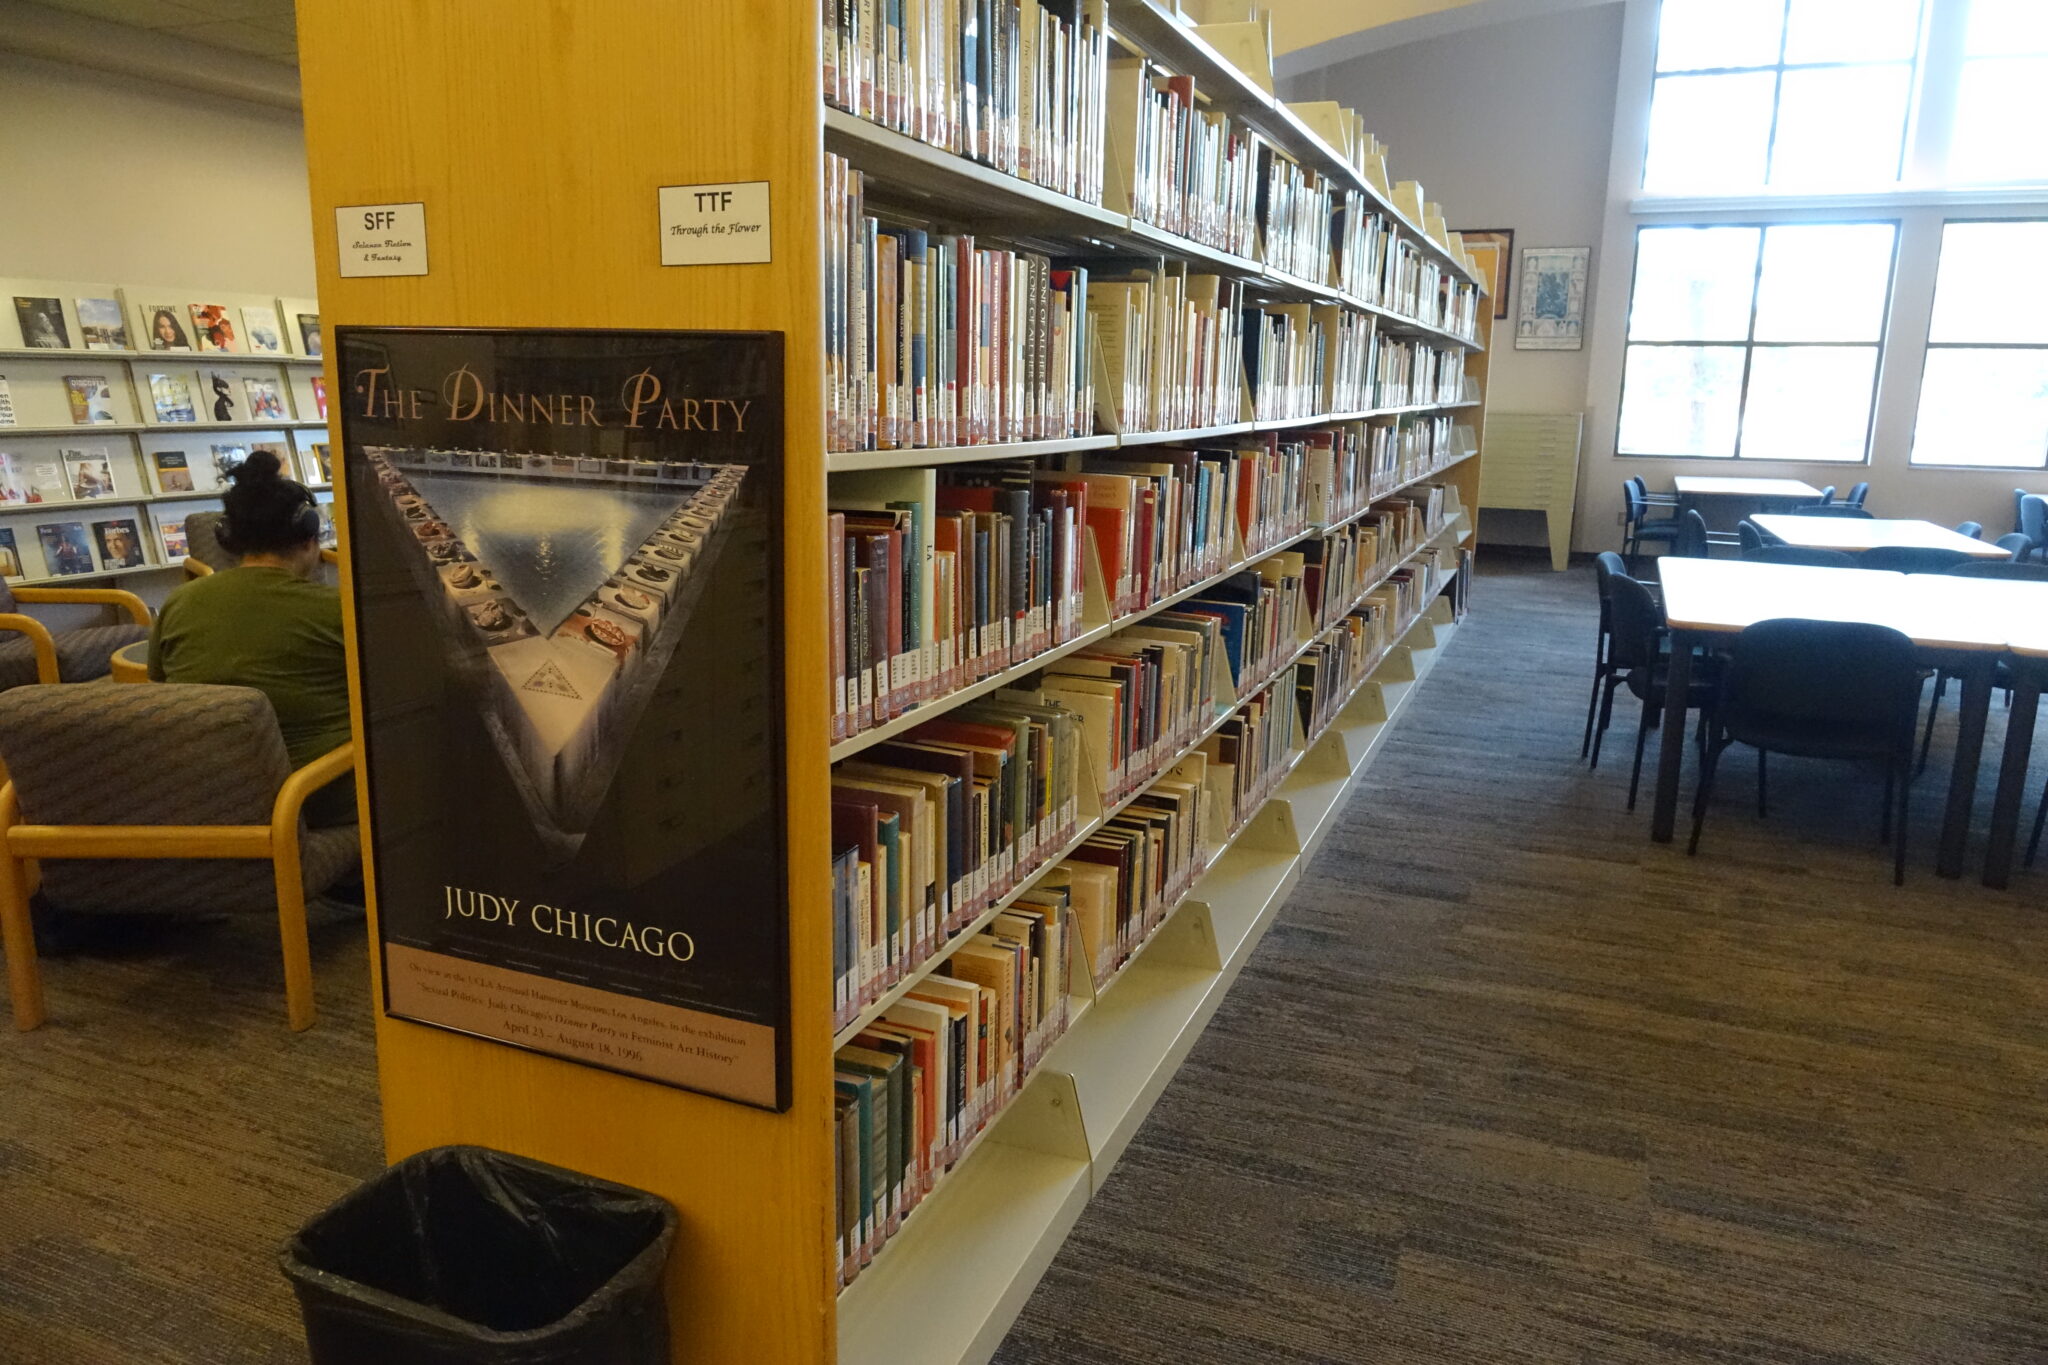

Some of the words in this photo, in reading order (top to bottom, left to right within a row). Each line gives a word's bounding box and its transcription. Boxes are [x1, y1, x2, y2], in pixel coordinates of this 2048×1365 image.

[694, 191, 732, 212] TTF
[364, 211, 395, 231] SFF
[671, 224, 709, 238] Through
[711, 222, 726, 234] the
[727, 222, 761, 235] Flower
[384, 240, 412, 248] Fiction
[354, 363, 424, 420] THE
[443, 362, 603, 427] DINNER
[621, 367, 752, 432] PARTY
[444, 886, 521, 927] JUDY
[530, 903, 696, 962] CHICAGO
[531, 989, 569, 1006] Hammer
[502, 1020, 530, 1036] April
[556, 1032, 595, 1051] August
[554, 1015, 589, 1030] Dinner
[590, 1022, 617, 1038] Party
[631, 1031, 675, 1051] Feminist
[676, 1042, 694, 1055] Art
